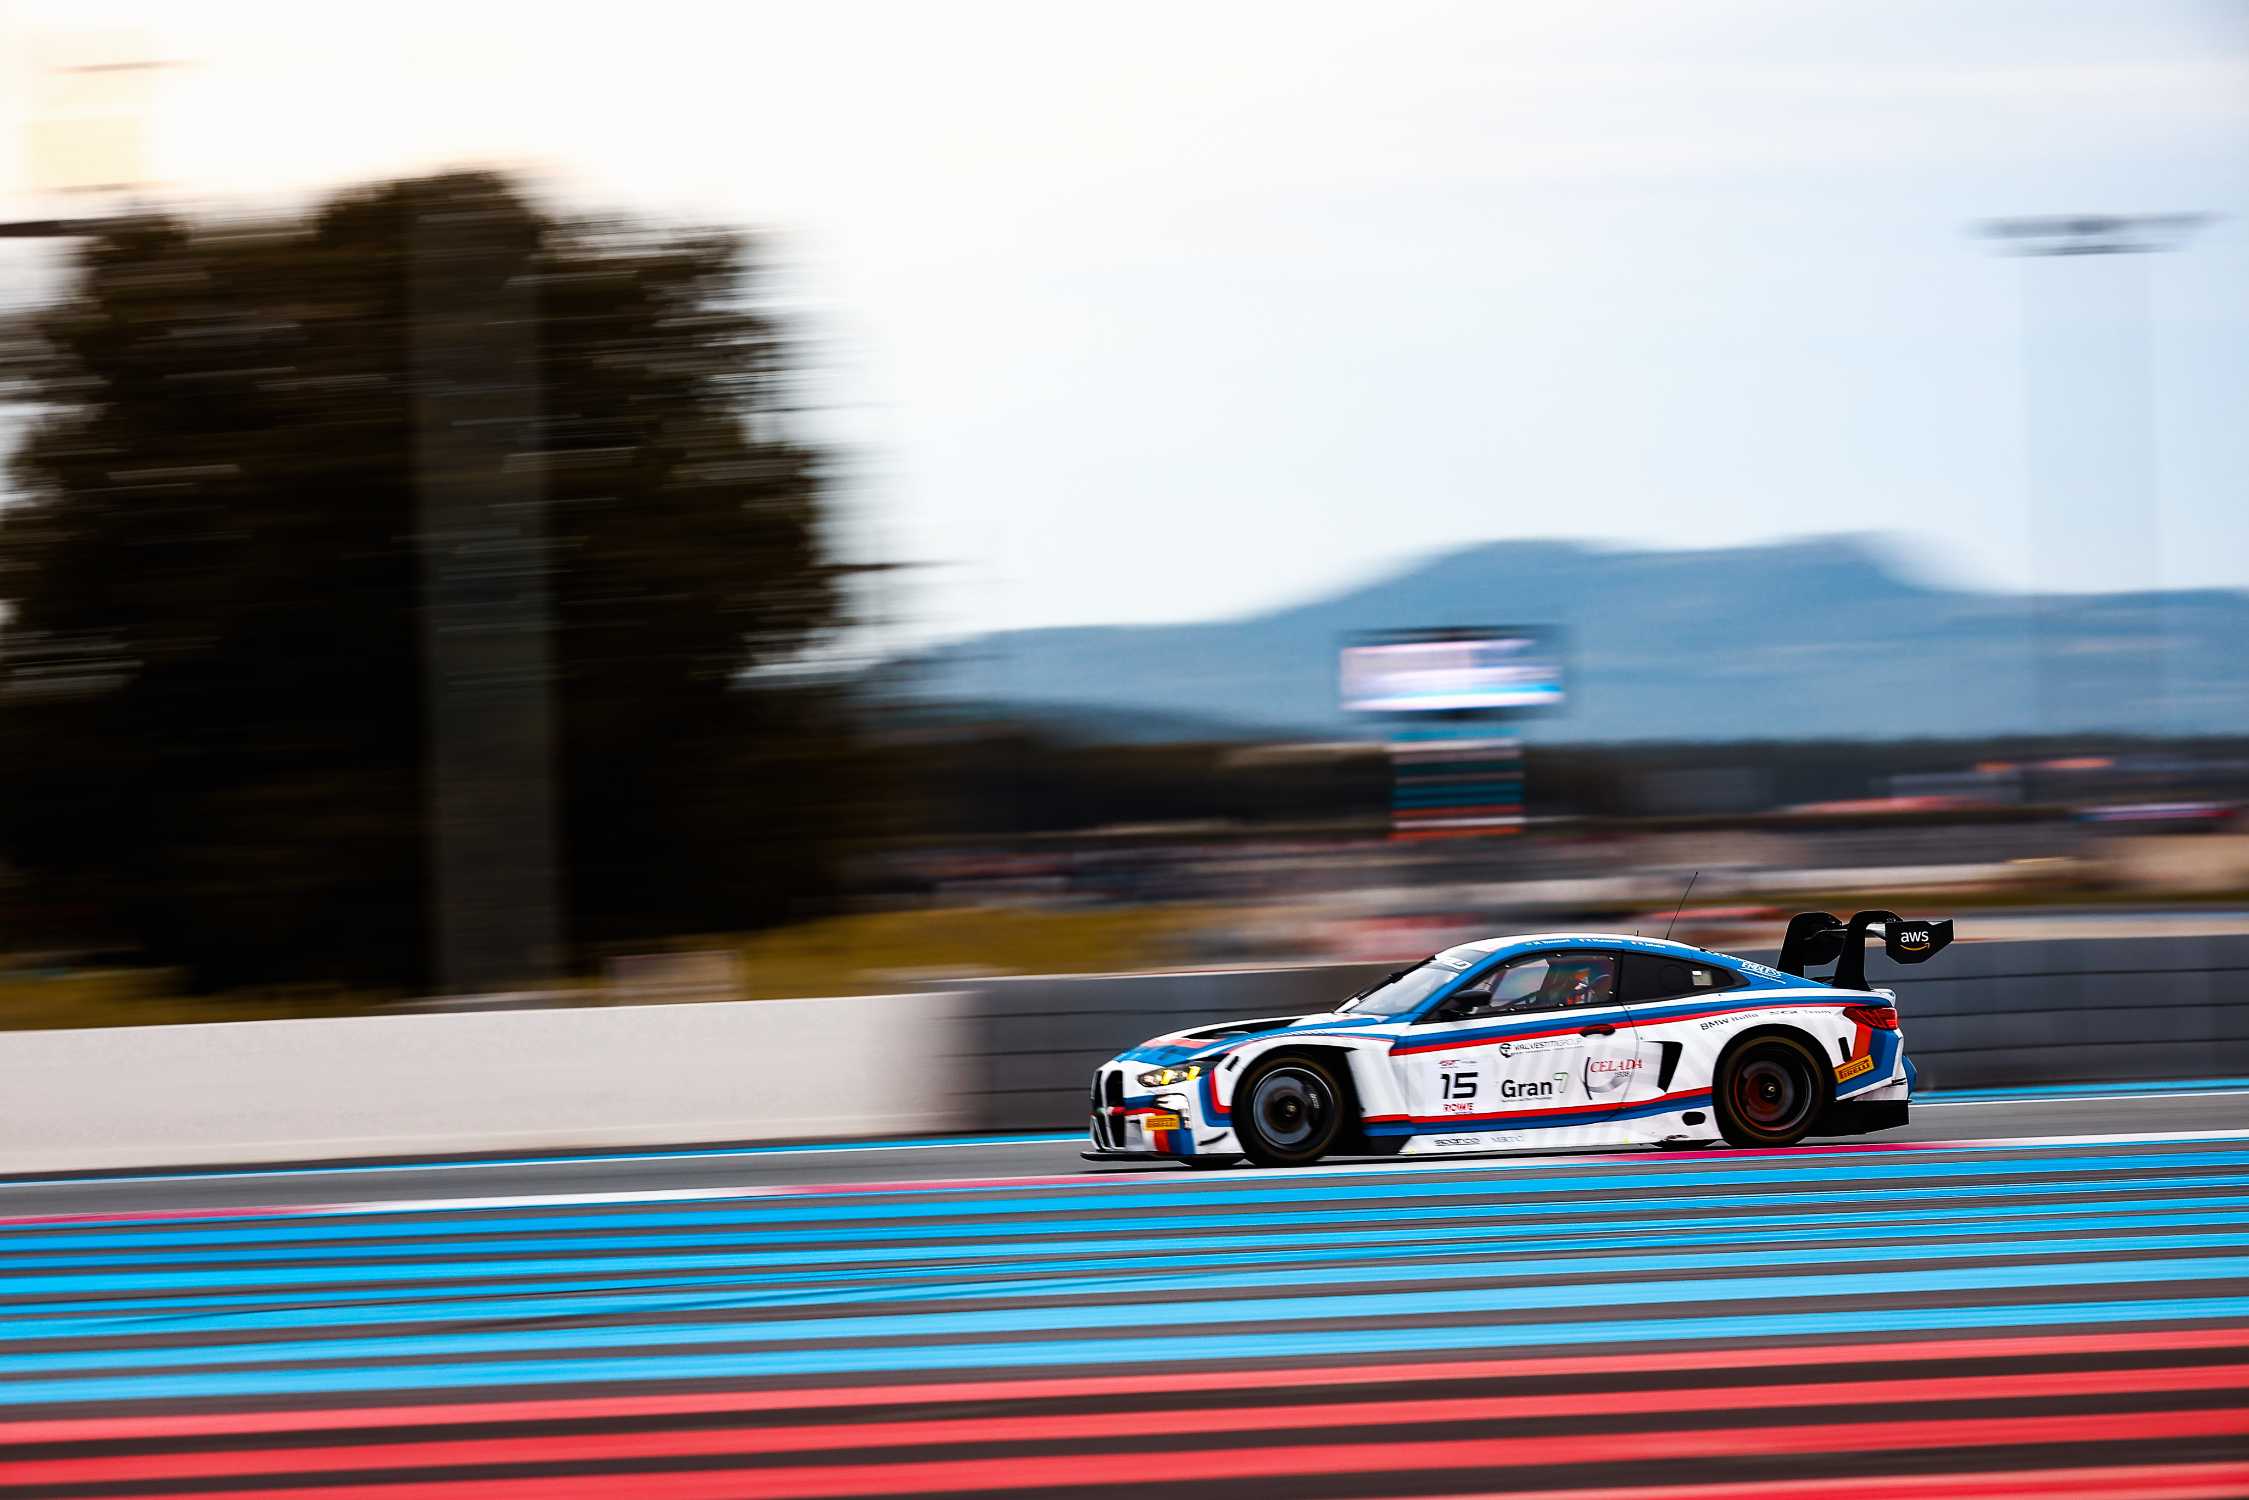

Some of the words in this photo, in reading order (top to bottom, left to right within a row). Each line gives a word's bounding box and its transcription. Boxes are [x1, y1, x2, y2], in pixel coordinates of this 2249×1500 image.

[1900, 930, 1929, 943] aws
[1700, 1019, 1729, 1031] BMW
[1590, 1058, 1643, 1073] CELADA
[1440, 1072, 1479, 1100] 15
[1501, 1079, 1553, 1098] Gran
